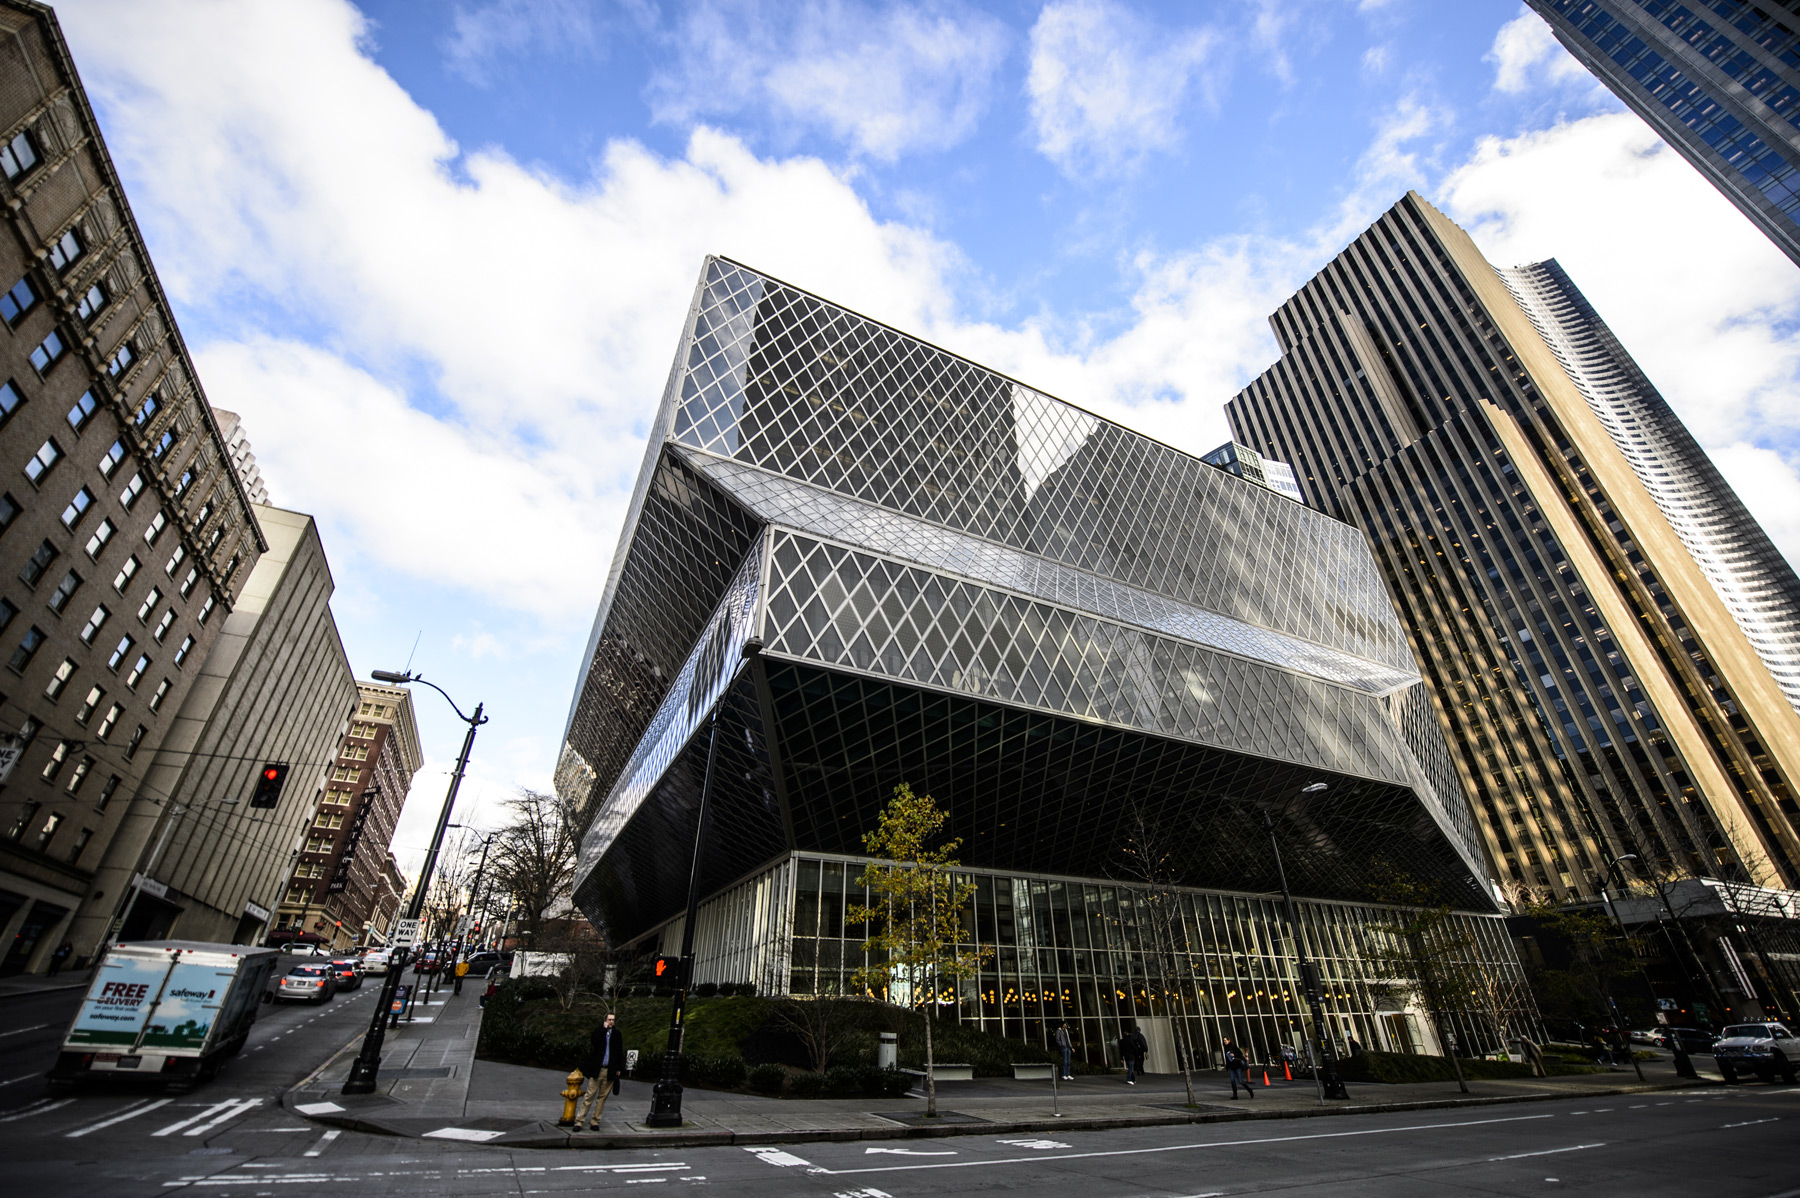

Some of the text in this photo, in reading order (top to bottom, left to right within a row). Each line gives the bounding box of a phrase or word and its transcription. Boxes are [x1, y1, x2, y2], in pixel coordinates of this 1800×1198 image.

[400, 921, 417, 929] ONE
[101, 982, 149, 998] FREE
[169, 988, 208, 999] safeway
[97, 997, 143, 1006] DELIVERY
[89, 1013, 136, 1022] safeway.com
